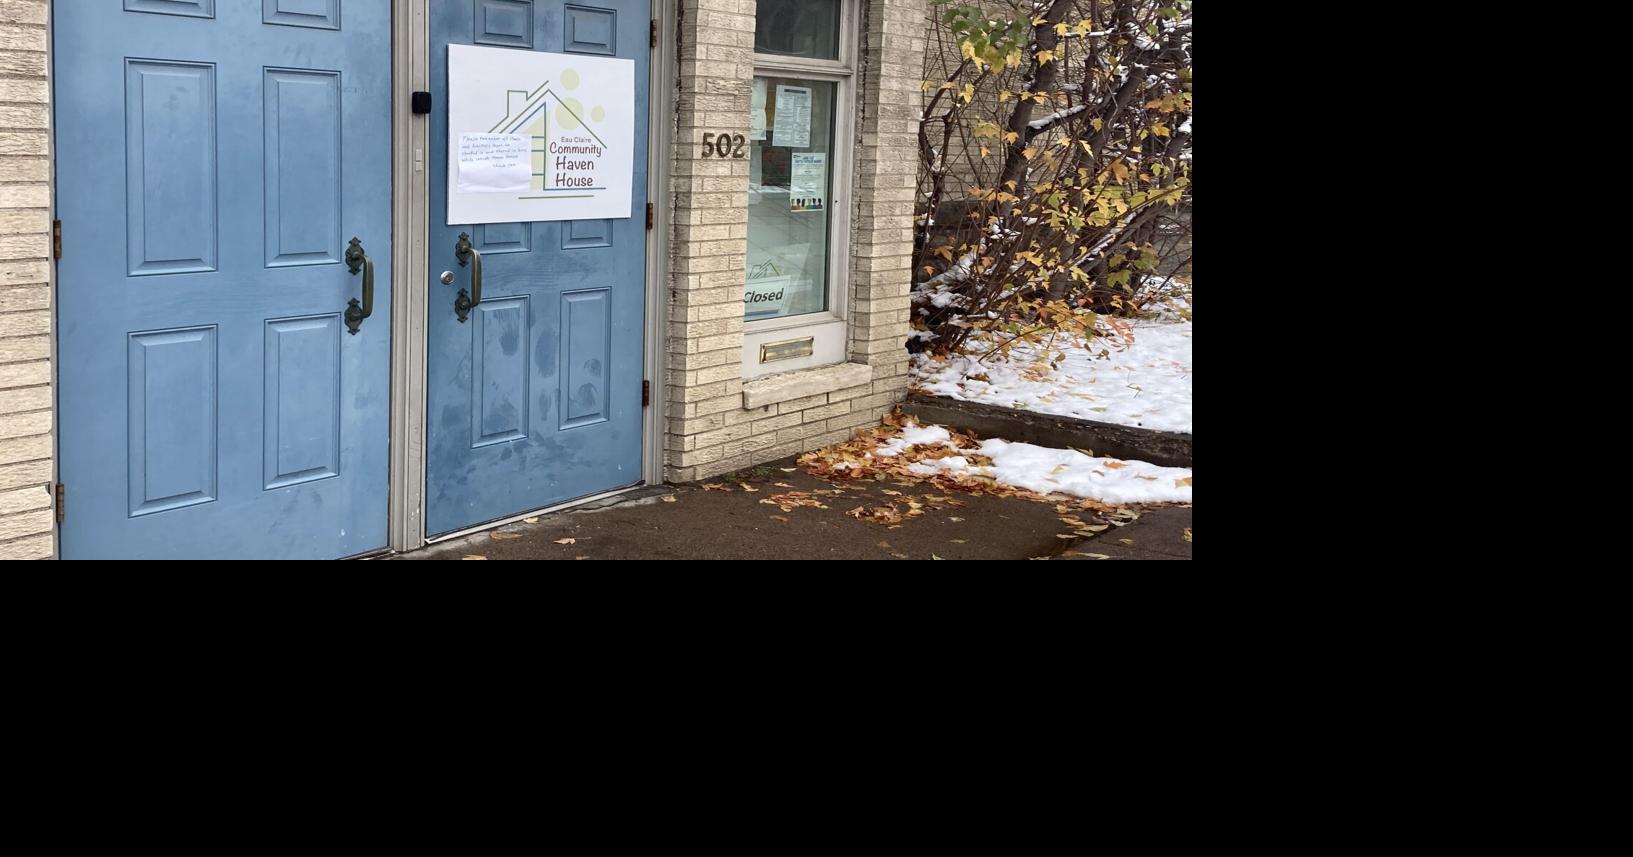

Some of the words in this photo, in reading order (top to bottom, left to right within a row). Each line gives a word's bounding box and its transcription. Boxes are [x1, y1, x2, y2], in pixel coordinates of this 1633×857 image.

[549, 141, 602, 158] Community
[701, 132, 746, 159] 502
[556, 155, 594, 170] Haven
[555, 172, 593, 187] House
[743, 287, 784, 304] Closed
